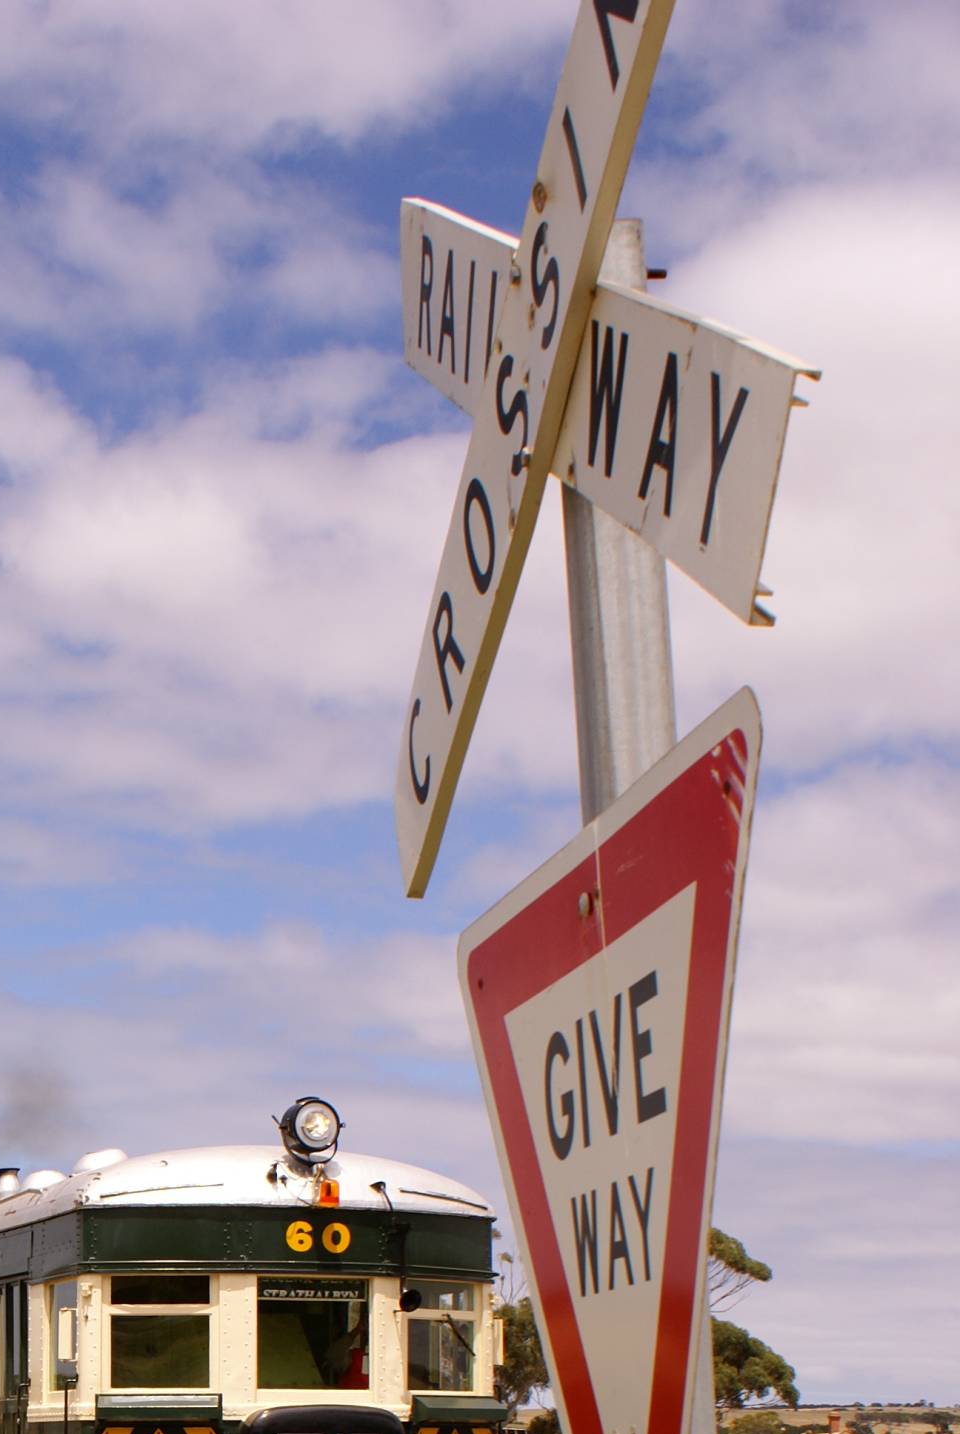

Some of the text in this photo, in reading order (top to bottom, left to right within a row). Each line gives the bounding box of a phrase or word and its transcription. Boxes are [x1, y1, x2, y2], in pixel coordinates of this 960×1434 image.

[587, 318, 750, 546] WAY
[544, 969, 667, 1161] GIVE
[285, 1220, 351, 1254] 60
[571, 1166, 654, 1297] WAY
